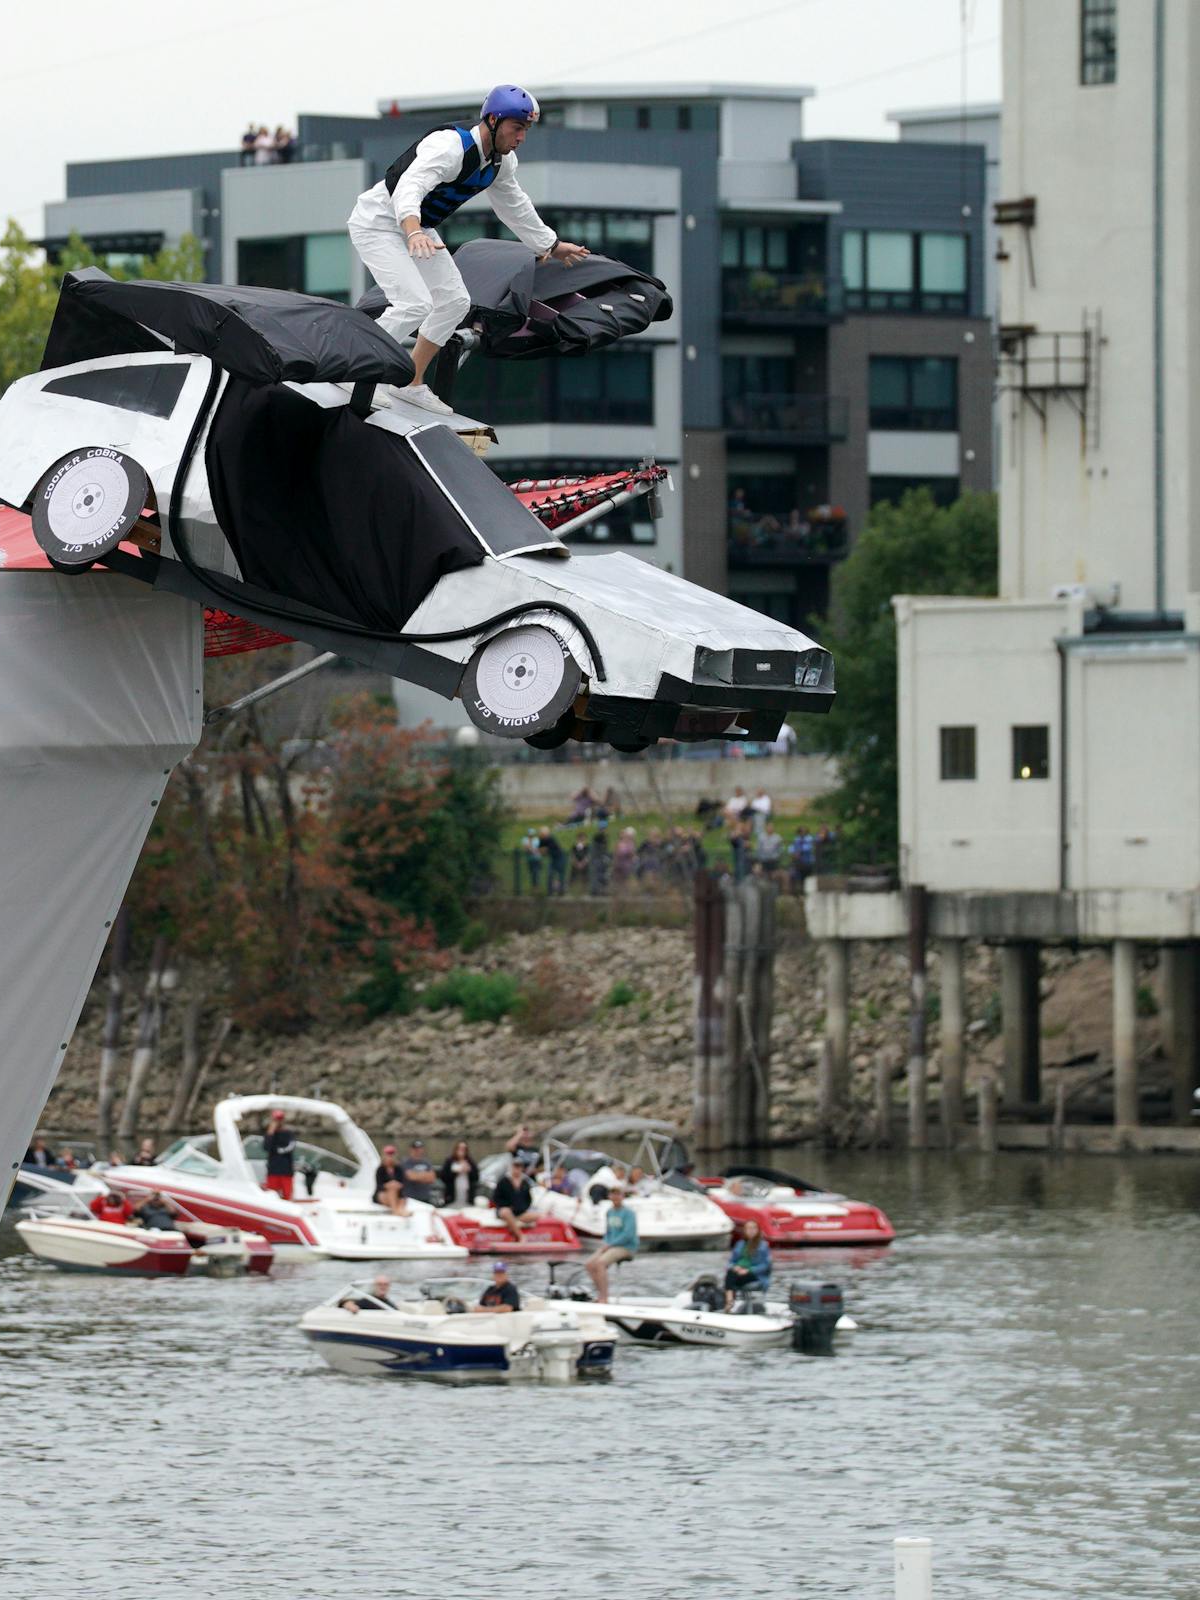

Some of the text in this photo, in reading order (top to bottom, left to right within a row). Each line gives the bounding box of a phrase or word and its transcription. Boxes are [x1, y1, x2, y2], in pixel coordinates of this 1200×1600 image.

[44, 448, 123, 500] COOPER COBRA
[62, 515, 127, 553] RADIAL G/T
[474, 700, 540, 726] RADIAL G/T
